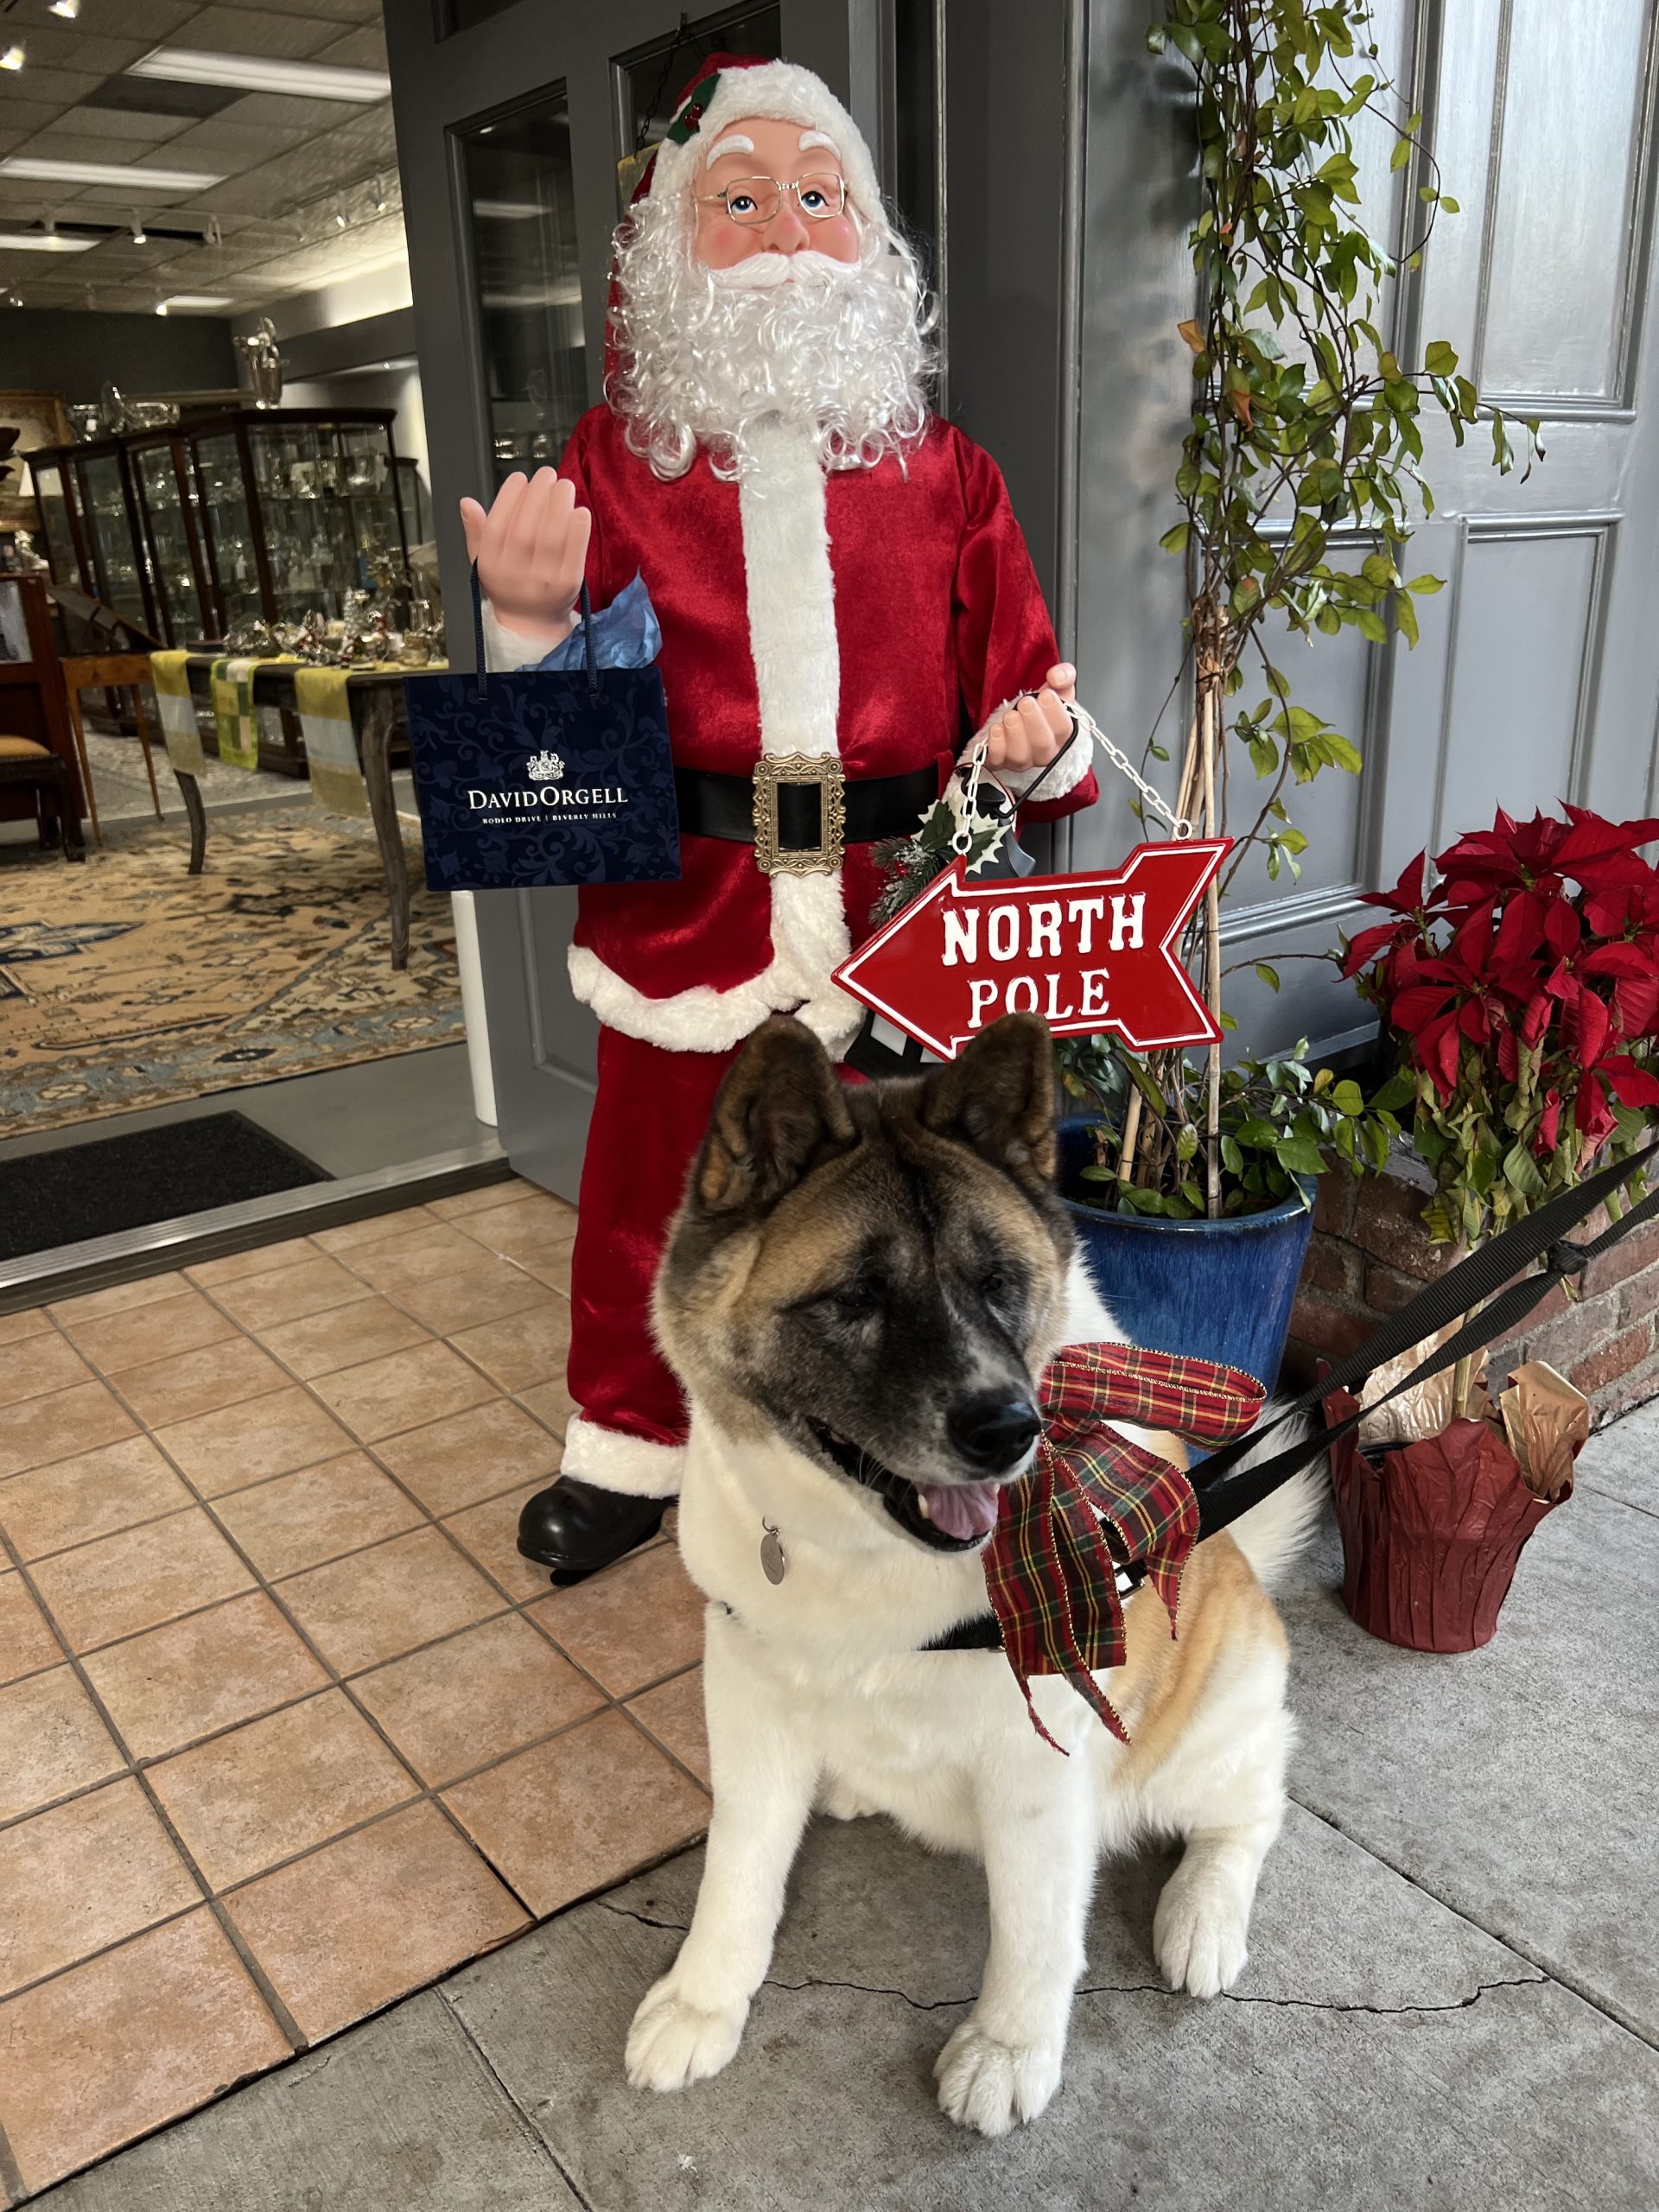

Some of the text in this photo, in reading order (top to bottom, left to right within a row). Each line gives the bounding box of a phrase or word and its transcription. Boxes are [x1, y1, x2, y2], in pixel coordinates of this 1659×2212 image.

[552, 813, 589, 822] BEVERLY
[941, 892, 1147, 966] NORTH
[967, 968, 1110, 1028] POLE
